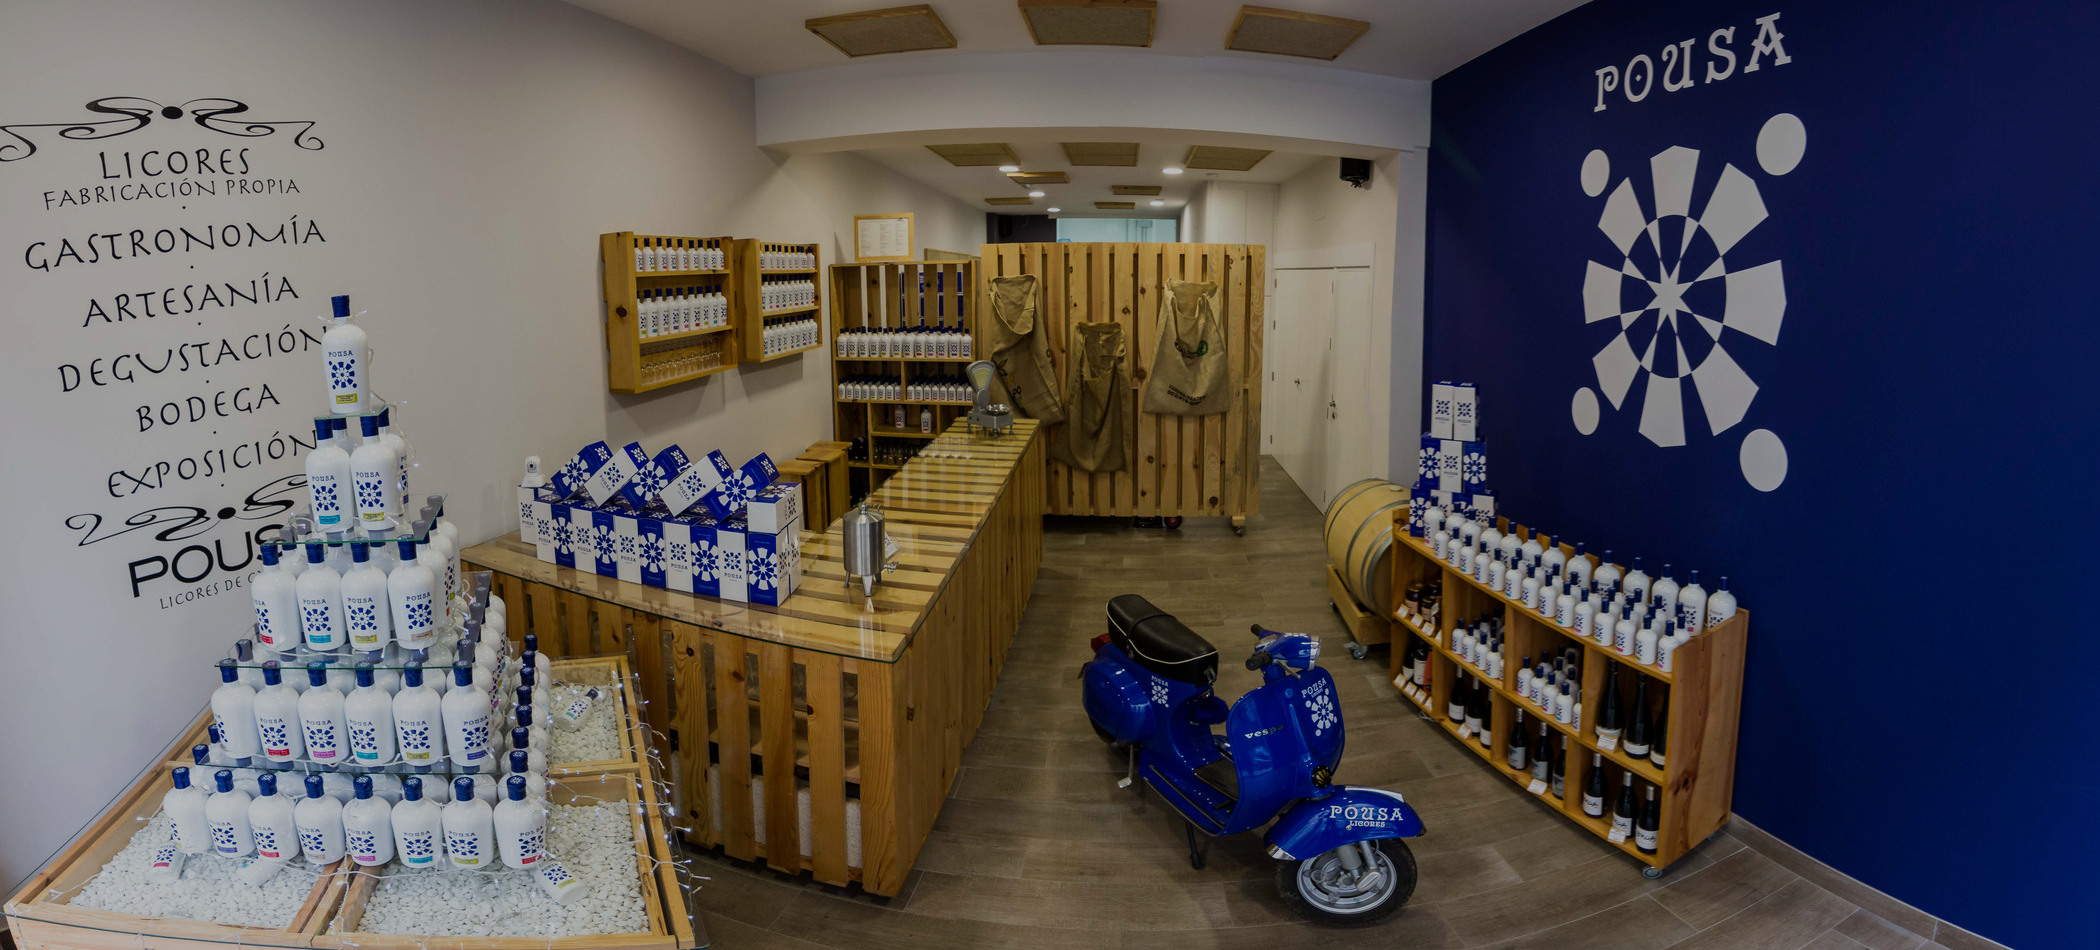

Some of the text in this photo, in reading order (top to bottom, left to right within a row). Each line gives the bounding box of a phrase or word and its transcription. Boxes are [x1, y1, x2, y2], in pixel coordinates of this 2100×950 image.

[1594, 11, 1792, 113] POUSA
[99, 147, 251, 181] LICORES
[43, 177, 301, 210] FABRICACIÓN PROPIA
[24, 214, 326, 273] GASTRONOMÍA
[82, 271, 299, 328] ARTESANÍA
[58, 324, 327, 393] DEGUSTACIÓN
[328, 350, 353, 358] POUSA
[136, 383, 280, 433] BODEGA
[107, 428, 318, 498] EXPOSICIÓN
[128, 522, 288, 598] POUS
[159, 582, 219, 610] LICORES
[224, 576, 243, 592] DE
[347, 596, 373, 604] POUSA
[406, 592, 431, 602] POUSA
[1301, 677, 1328, 699] POUSA
[349, 719, 373, 727] POUSA
[463, 715, 489, 726] POUSA
[1329, 805, 1404, 822] POUSA
[1349, 820, 1386, 828] LICORES
